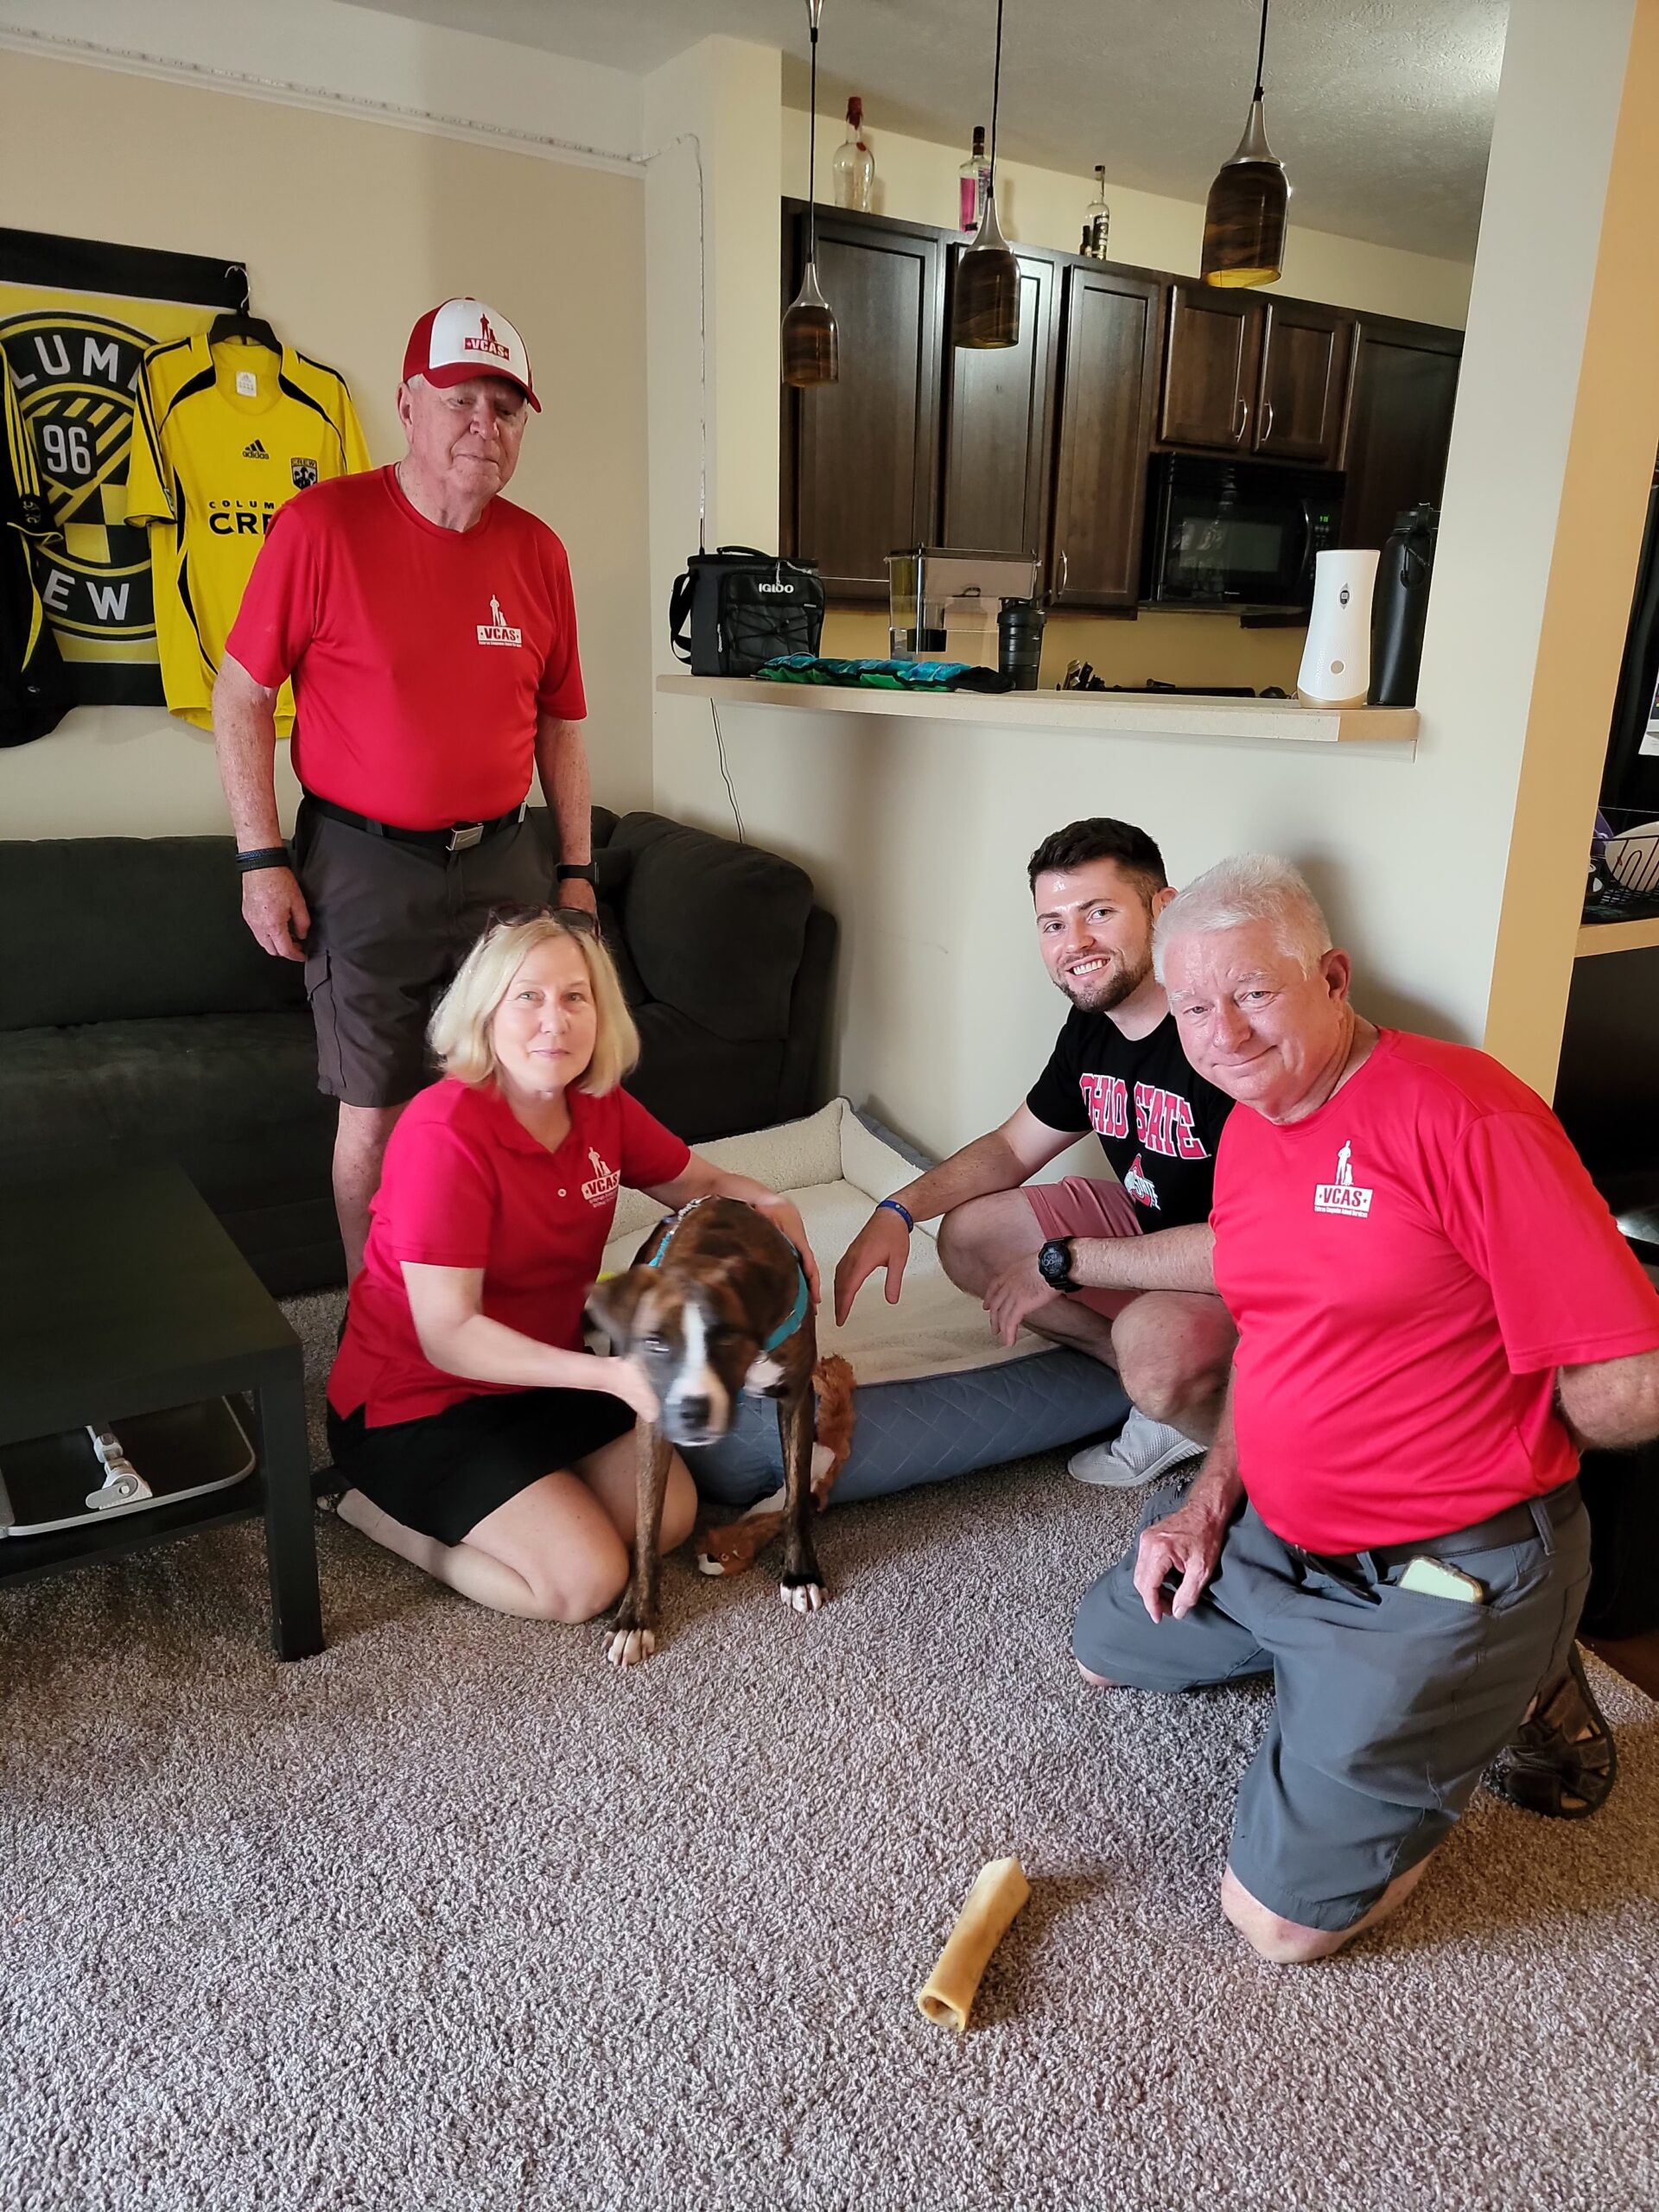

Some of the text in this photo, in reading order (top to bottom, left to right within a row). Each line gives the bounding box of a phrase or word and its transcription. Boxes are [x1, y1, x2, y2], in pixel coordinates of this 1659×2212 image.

[471, 338, 505, 357] VCAS
[43, 424, 92, 474] 96
[242, 450, 270, 460] adidas
[758, 582, 794, 594] IGLOO
[484, 627, 516, 641] VCAS
[1134, 1081, 1210, 1160] STATE
[588, 1173, 619, 1196] VCAS
[1323, 1187, 1363, 1208] VCAS
